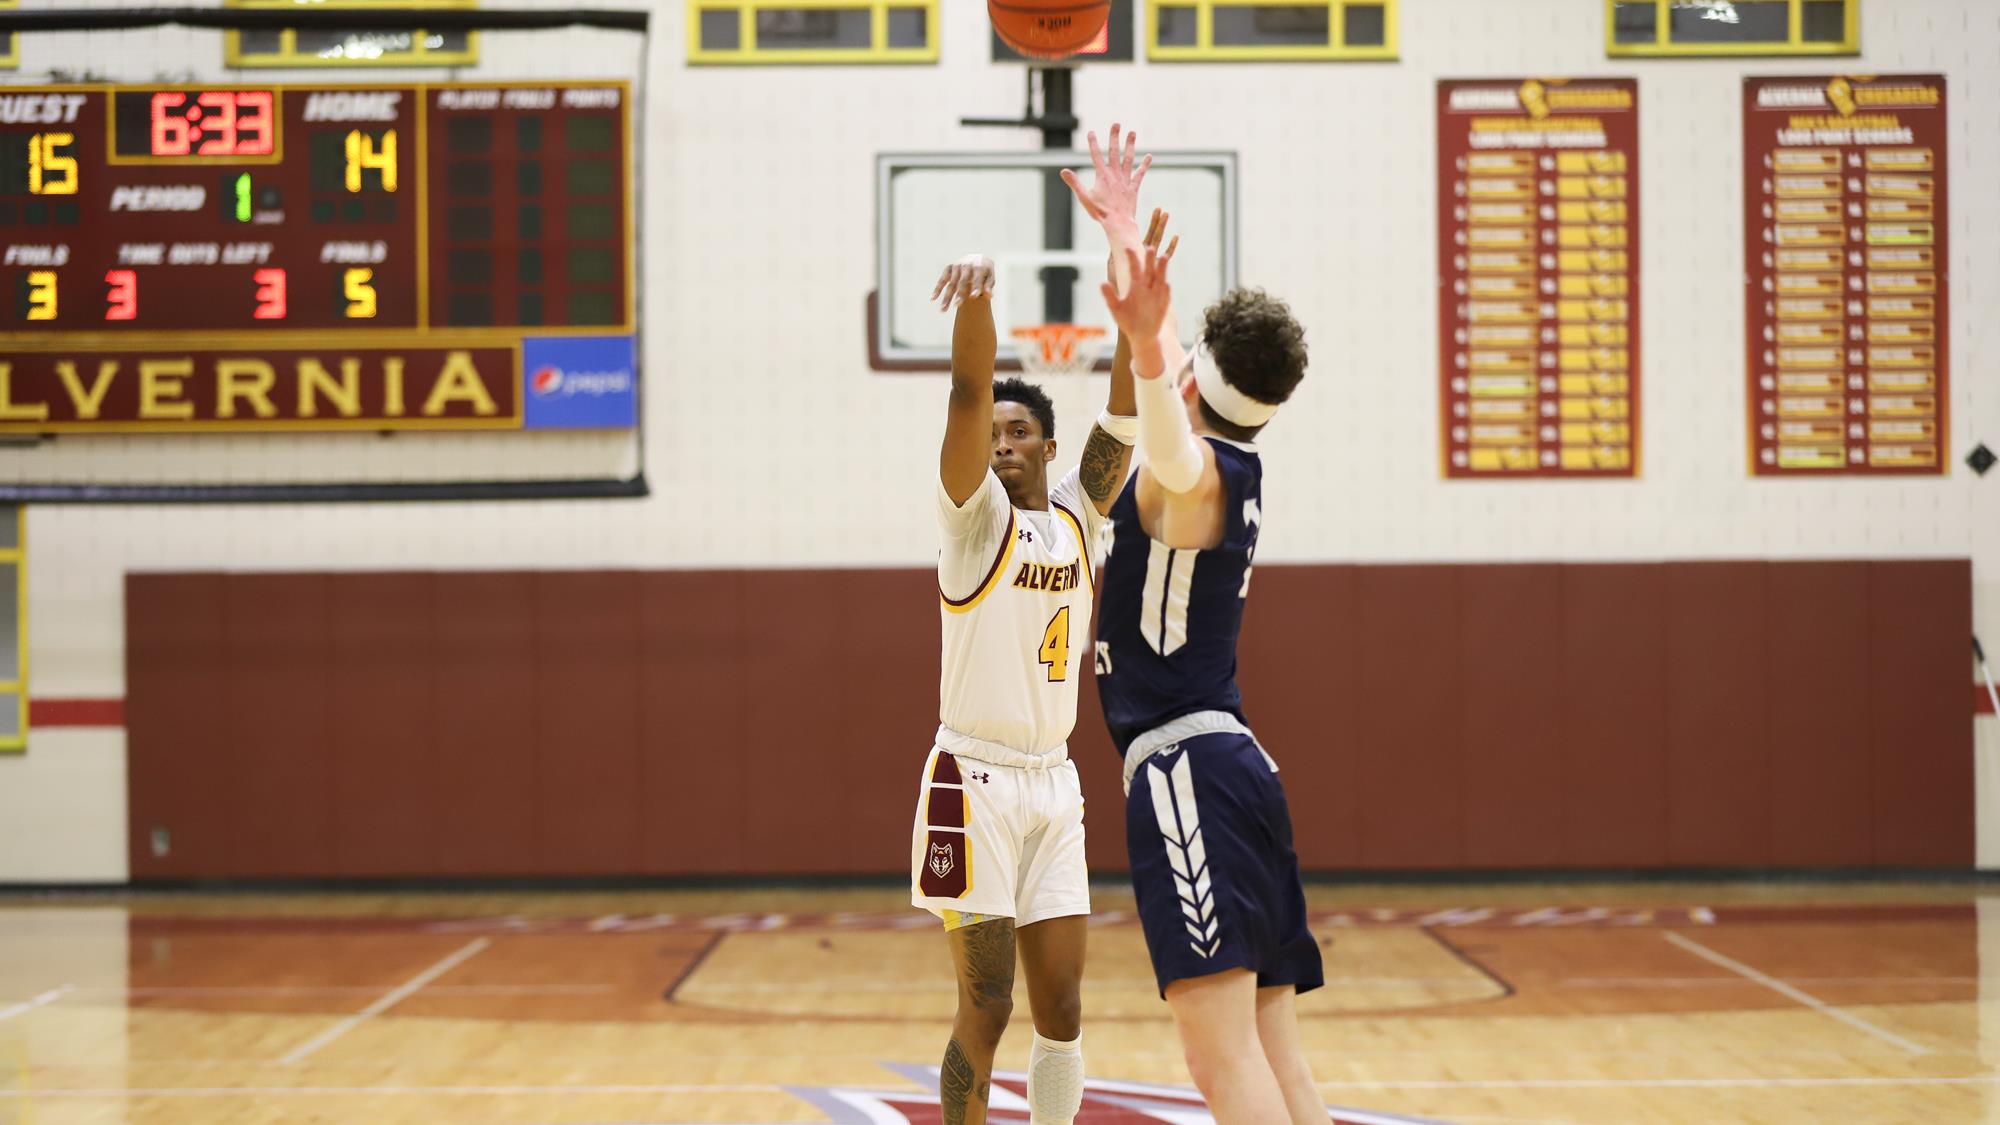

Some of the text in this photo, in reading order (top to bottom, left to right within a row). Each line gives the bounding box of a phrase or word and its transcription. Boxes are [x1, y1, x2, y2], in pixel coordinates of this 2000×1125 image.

[0, 93, 87, 124] UEST
[151, 91, 273, 155] 6:33
[303, 91, 402, 121] HOME
[28, 132, 78, 194] 15
[344, 129, 397, 193] 14
[110, 186, 206, 211] PERIOD
[236, 172, 251, 222] 1
[26, 270, 57, 320] 3
[104, 269, 137, 320] 3
[253, 268, 287, 319] 3
[344, 267, 377, 318] 5
[1038, 604, 1070, 682] 4
